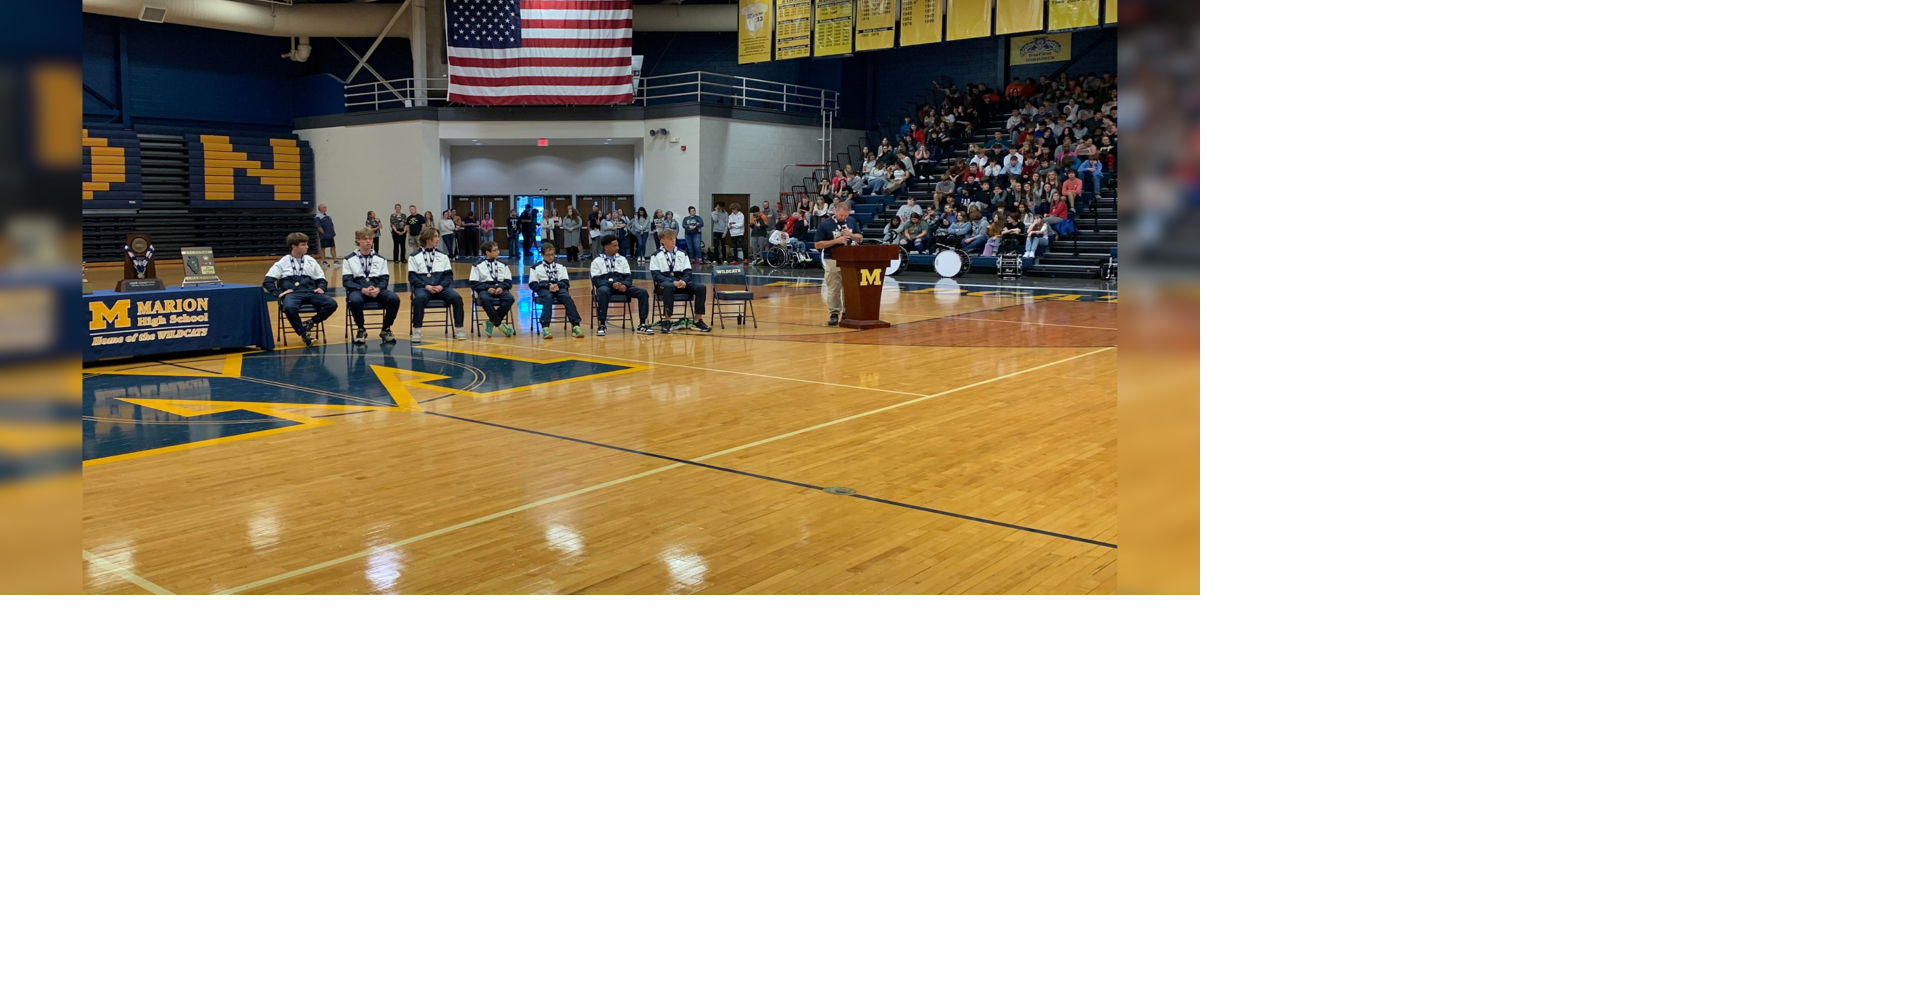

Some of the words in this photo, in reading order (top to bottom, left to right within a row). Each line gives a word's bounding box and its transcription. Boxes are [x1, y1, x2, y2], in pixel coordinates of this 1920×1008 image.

[860, 269, 882, 286] M
[89, 299, 131, 330] M
[137, 298, 209, 316] MARION
[137, 316, 167, 327] High
[169, 313, 208, 323] School
[91, 336, 124, 346] Home
[125, 333, 138, 342] of
[138, 332, 156, 341] the
[157, 327, 208, 340] WILDCATS
